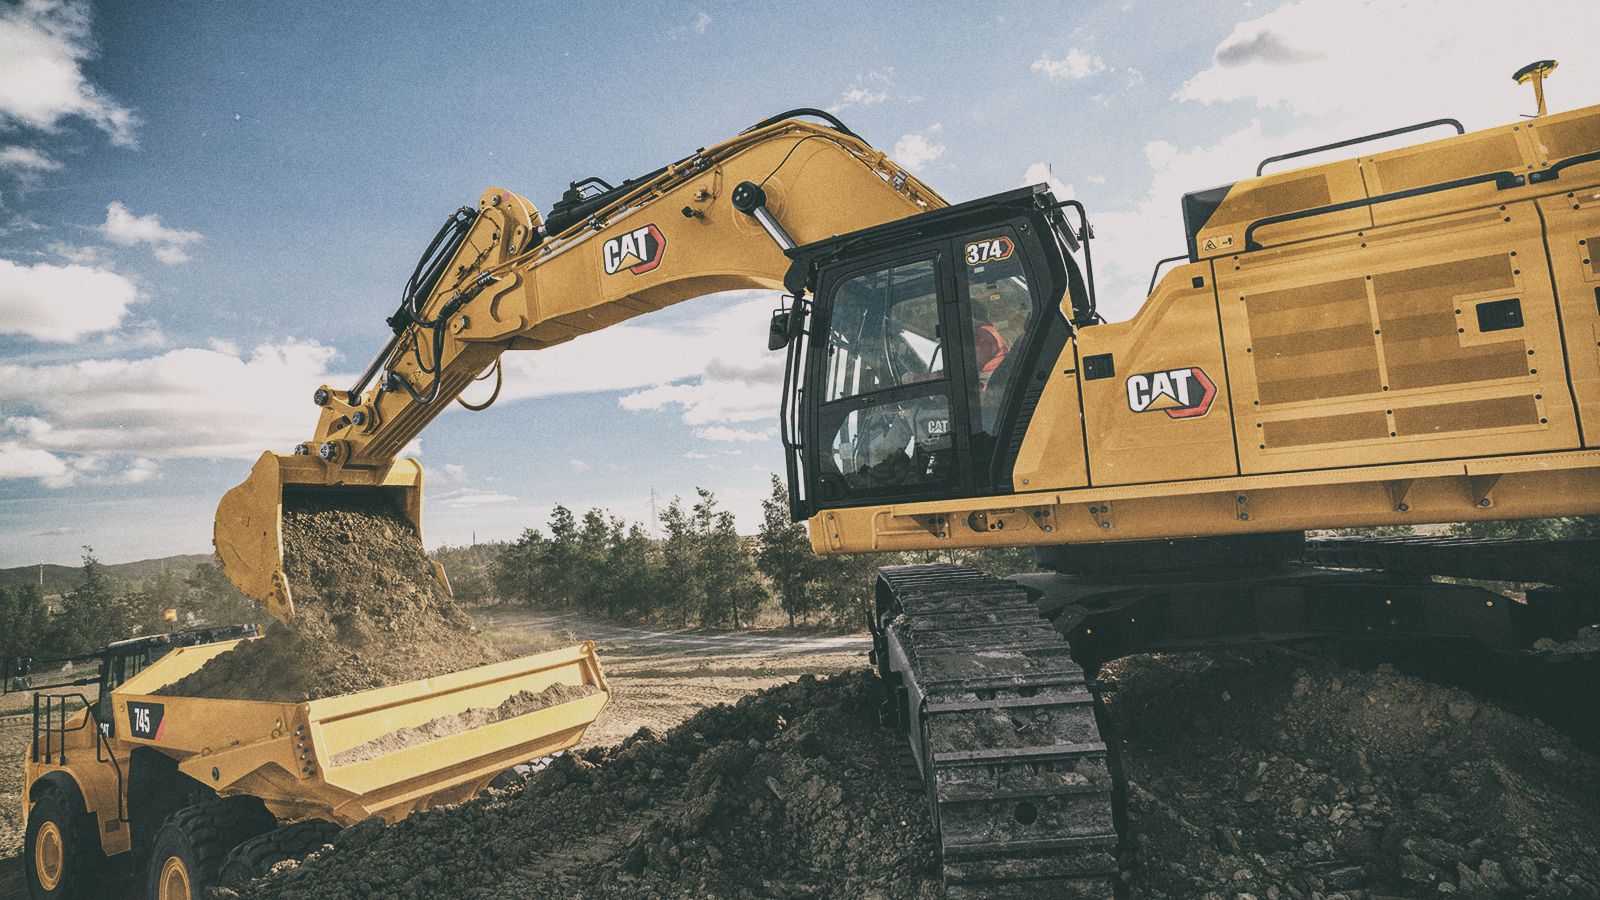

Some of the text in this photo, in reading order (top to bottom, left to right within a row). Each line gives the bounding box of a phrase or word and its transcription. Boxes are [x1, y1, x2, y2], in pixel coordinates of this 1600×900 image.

[603, 226, 649, 274] CAT
[966, 239, 1002, 263] 374
[1127, 368, 1192, 412] CAT
[928, 420, 949, 434] CAT
[134, 707, 151, 733] 745
